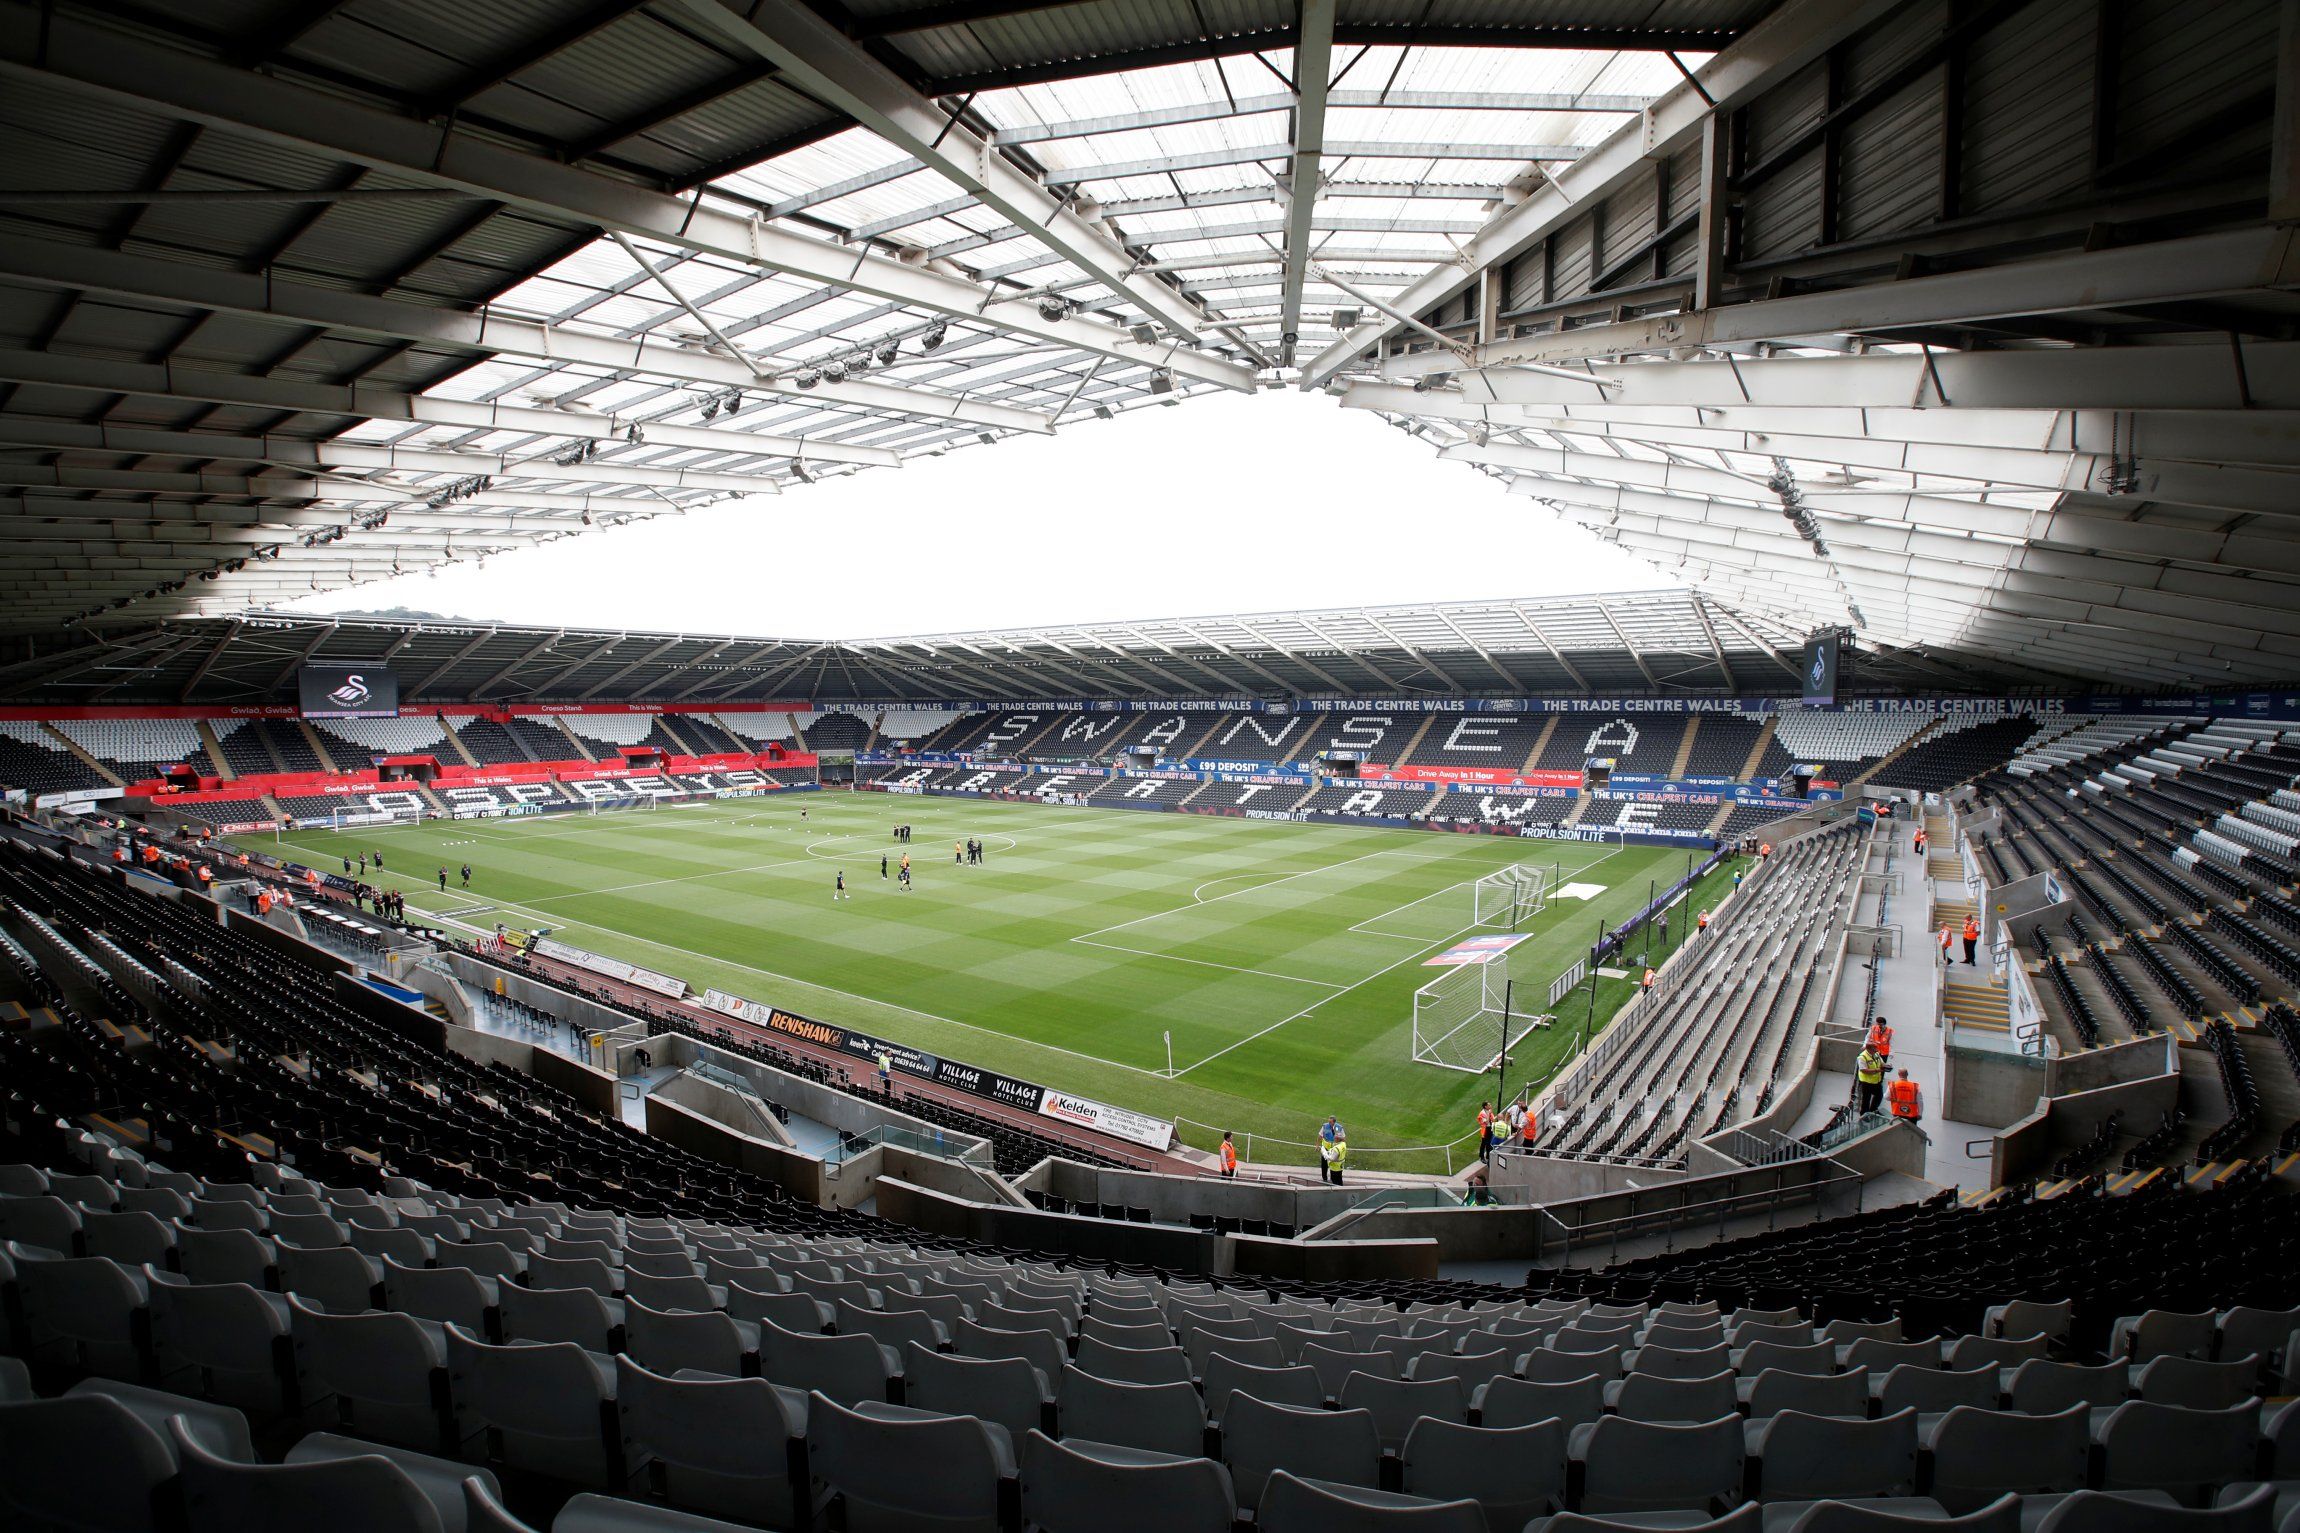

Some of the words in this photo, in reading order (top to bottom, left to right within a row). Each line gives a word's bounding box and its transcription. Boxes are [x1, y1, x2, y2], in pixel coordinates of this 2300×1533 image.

[877, 703, 911, 711] CENTRE
[913, 703, 942, 711] WALES
[1001, 702, 1024, 710] TRADE
[1026, 702, 1055, 710] CENTRE
[1056, 702, 1083, 710] WALES
[1130, 702, 1147, 710] THE
[1148, 702, 1179, 710] TRADE
[1180, 702, 1216, 710] CENTRE
[1218, 702, 1251, 710] WALES
[1311, 701, 1332, 710] THE
[1333, 701, 1372, 710] TRADE
[1374, 701, 1420, 710] CENTRE
[1422, 700, 1465, 710] WALES
[1542, 700, 1569, 711] THE
[1571, 700, 1621, 711] TRADE
[1624, 700, 1683, 711] CENTRE
[1686, 700, 1742, 711] WALES
[1845, 700, 1873, 712] HE
[1878, 700, 1936, 712] TRADE
[1940, 700, 2006, 713] CENTRE
[2009, 700, 2065, 714] WALES
[1040, 765, 1050, 773] THE
[1050, 766, 1062, 774] UK'S
[1089, 768, 1104, 776] CARS
[1199, 761, 1216, 771] £99
[1180, 772, 1197, 780] CARS
[1221, 774, 1234, 782] THE
[1249, 776, 1284, 784] CHEAPEST
[1284, 777, 1304, 785] CARS
[1417, 769, 1438, 778] Drive
[1439, 771, 1458, 780] Away
[1475, 772, 1495, 780] Hour
[1331, 779, 1346, 787] THE
[1346, 780, 1363, 788] UK'S
[1363, 780, 1402, 790] CHEAPEST
[1403, 781, 1426, 790] CARS
[715, 790, 752, 799] PROPULSION
[753, 789, 765, 797] LITE
[1458, 785, 1473, 793] THE
[1474, 785, 1493, 794] UK'S
[1495, 786, 1539, 796] CHEAPEST
[1540, 788, 1566, 797] CARS
[1076, 797, 1089, 807] LITE
[1594, 790, 1610, 800] THE
[1612, 791, 1635, 800] UK'S
[1636, 792, 1687, 803] CHEAPEST
[1689, 794, 1718, 804] CARS
[1736, 797, 1749, 805] THE
[1765, 799, 1795, 808] CHEAPEST
[1796, 802, 1812, 810] CARS
[526, 805, 543, 815] LITE
[1245, 809, 1291, 821] PROPULSION
[1291, 812, 1308, 822] LITE
[1520, 827, 1582, 841] PROPULSION
[1583, 830, 1606, 843] LITE
[770, 1012, 835, 1044] RENISHAW
[901, 1051, 921, 1061] advice?
[909, 1061, 916, 1069] 64
[923, 1065, 930, 1073] 64
[942, 1062, 981, 1084] VILLAGE
[939, 1074, 958, 1084] HOTEL
[960, 1080, 976, 1090] CLUB
[996, 1079, 1038, 1101] VILLAGE
[993, 1091, 1013, 1102] HOTEL
[1016, 1098, 1034, 1108] CLUB
[1058, 1097, 1098, 1118] Kelden
[1101, 1112, 1117, 1121] ACCESS
[1118, 1117, 1137, 1127] CONTROL
[1137, 1122, 1156, 1132] SYSTEMS
